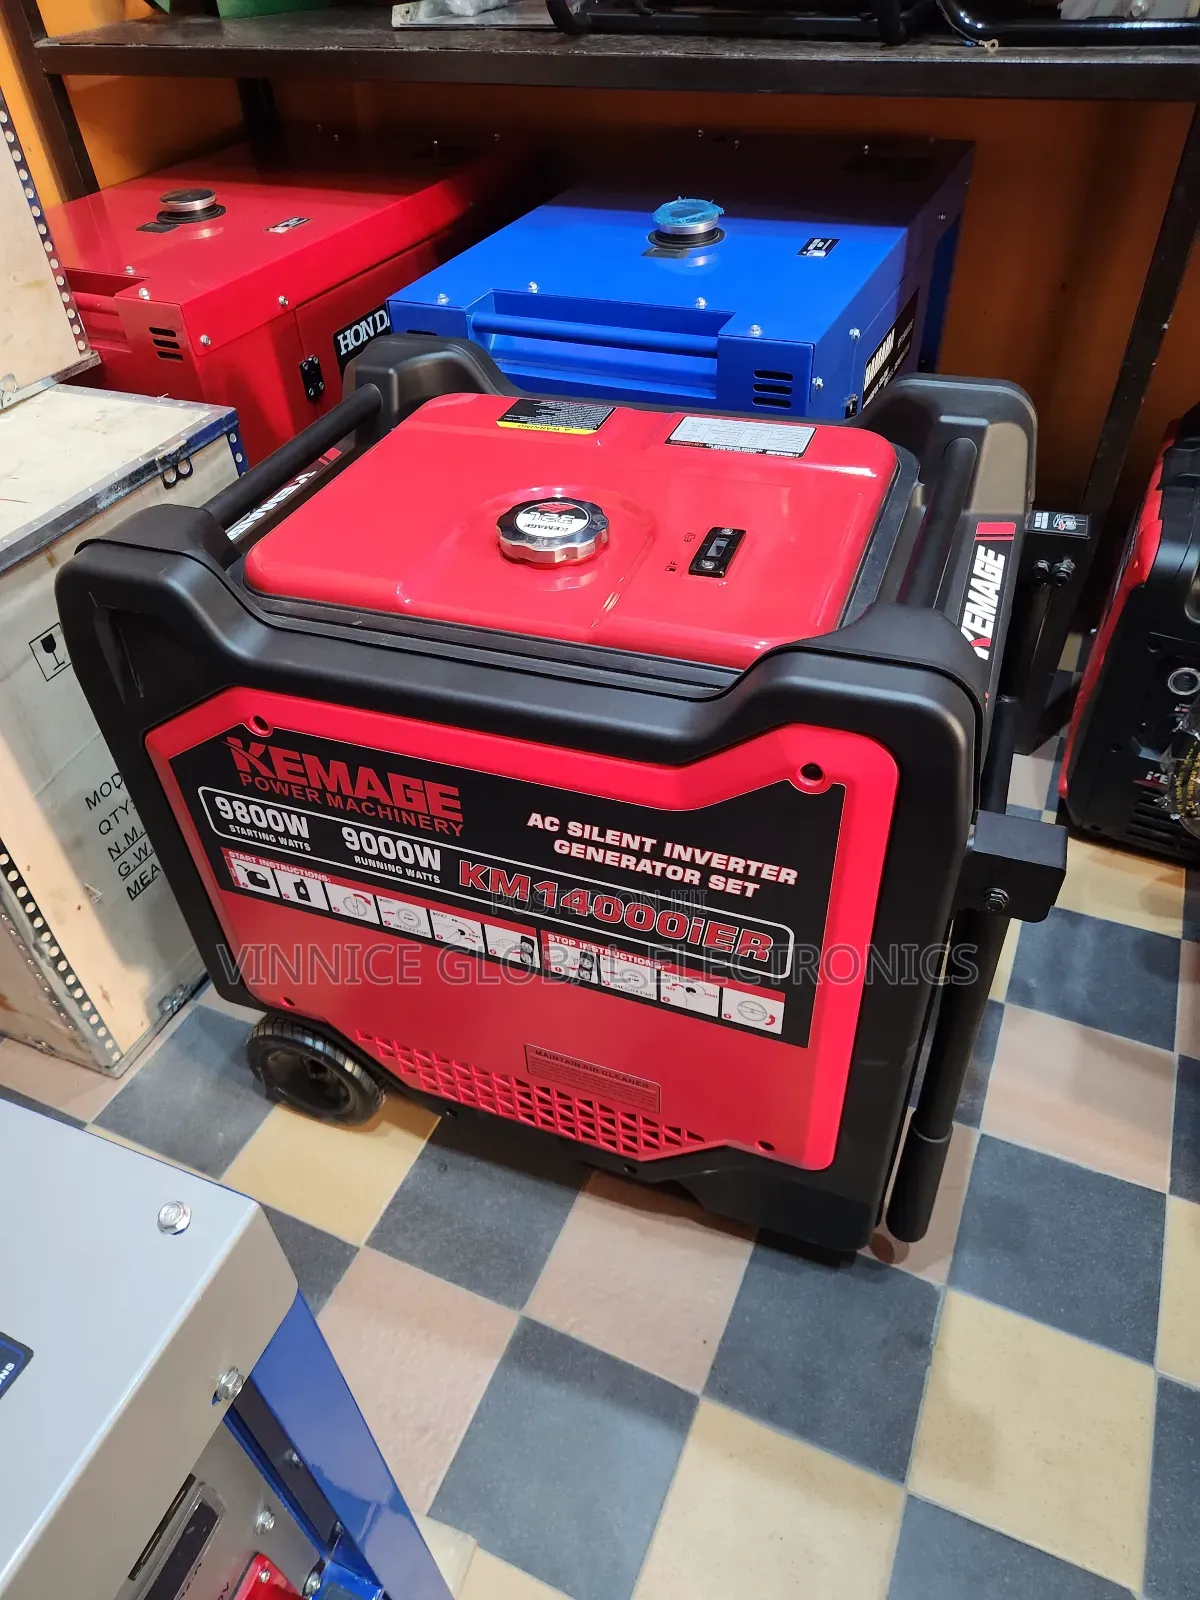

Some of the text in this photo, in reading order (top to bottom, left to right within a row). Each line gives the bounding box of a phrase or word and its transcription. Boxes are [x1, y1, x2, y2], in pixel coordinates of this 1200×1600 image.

[523, 521, 569, 532] KEMAGE
[961, 544, 1006, 661] KEMAGE
[221, 736, 464, 823] KEMAGE
[239, 772, 464, 837] POWER MACHINERY
[214, 795, 442, 872] 9800W 9000W
[228, 823, 311, 852] STARTING WATTS
[228, 850, 257, 863] START
[526, 812, 799, 886] AC SILENT INVERTER
[354, 854, 441, 884] RUNNING WATTS
[553, 839, 761, 898] GENERATOR SET
[458, 859, 775, 963] KM14000iER
[547, 933, 576, 946] STOP
[535, 1049, 650, 1089] MAINTAIN AIR CLEANER
